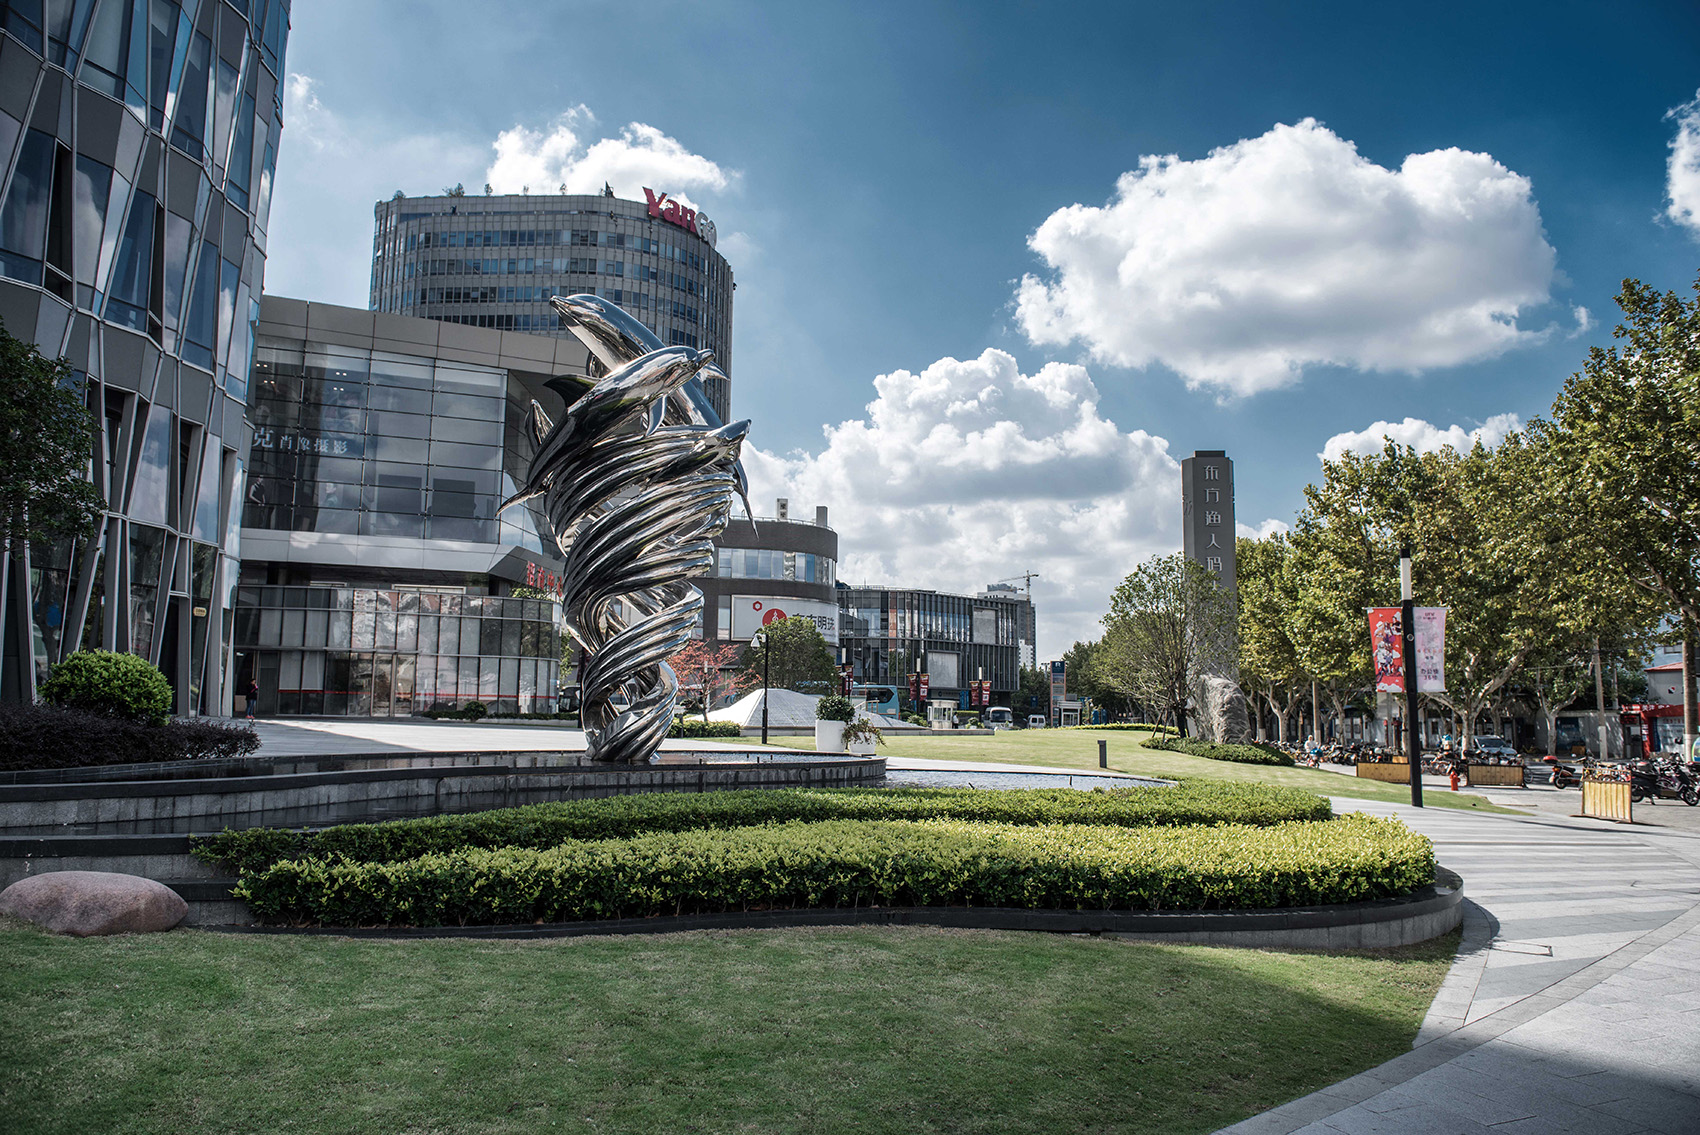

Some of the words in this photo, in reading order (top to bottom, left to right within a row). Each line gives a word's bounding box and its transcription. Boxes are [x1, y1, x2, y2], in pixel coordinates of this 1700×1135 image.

[1203, 465, 1223, 591] 东方渔人码
